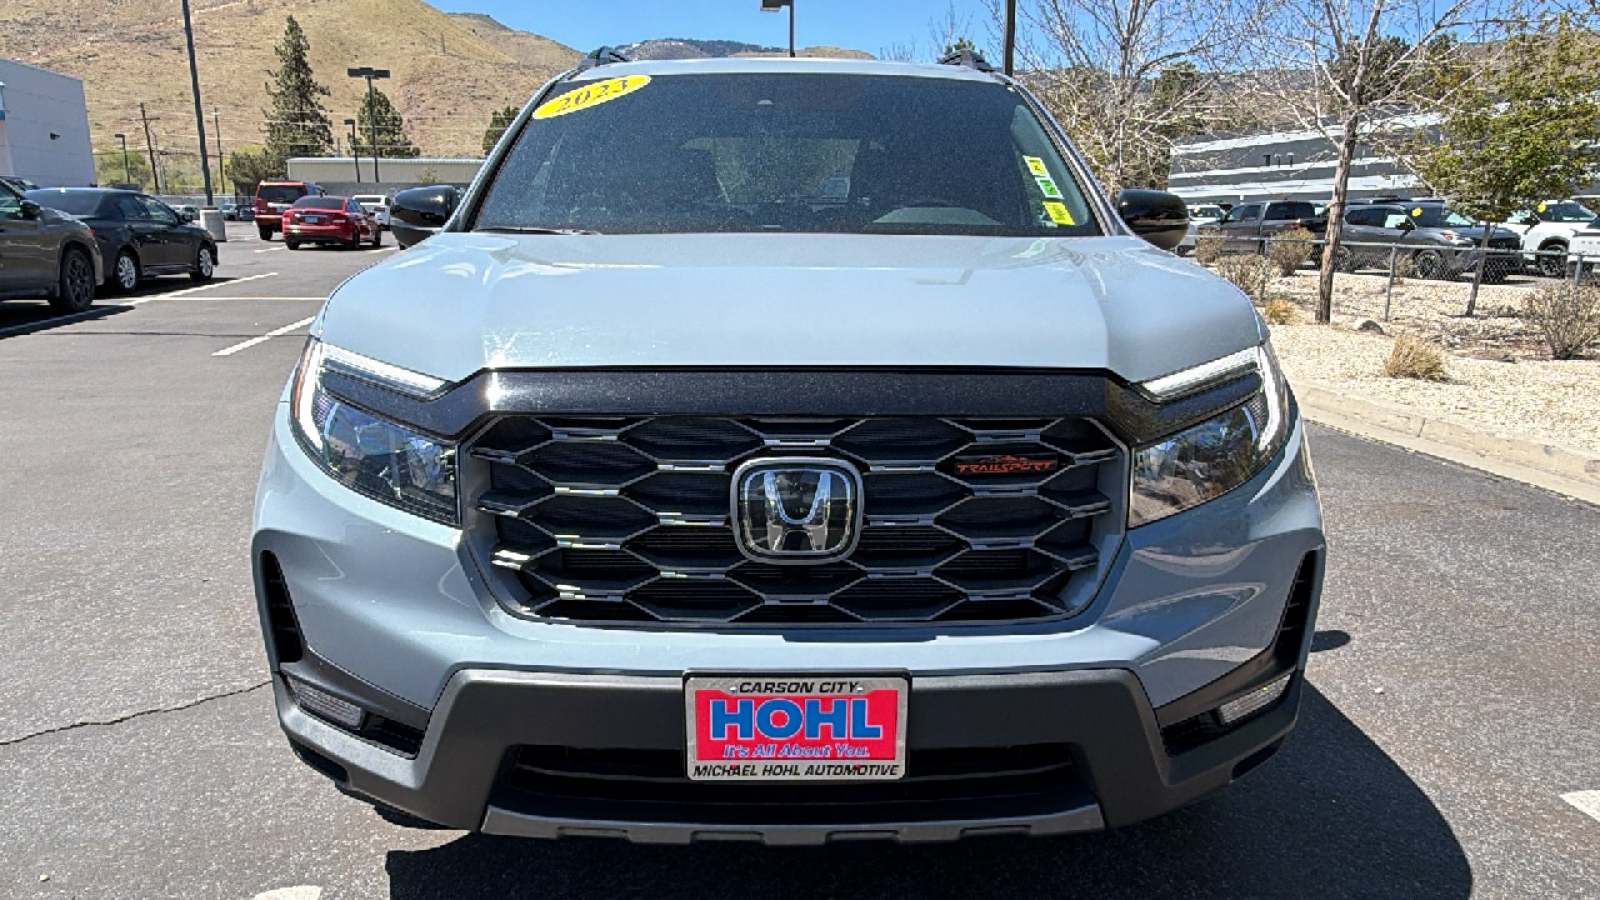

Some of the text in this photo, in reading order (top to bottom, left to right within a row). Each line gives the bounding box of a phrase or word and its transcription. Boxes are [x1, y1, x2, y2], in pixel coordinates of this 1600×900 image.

[556, 79, 628, 112] 2023
[957, 461, 1052, 473] TRAILSPORT
[739, 681, 860, 694] CARSON CITY
[710, 698, 883, 740] HOHL
[723, 744, 870, 758] It's All About You.
[693, 764, 900, 777] MICHAEL HOHL AUTOMOTIVE
